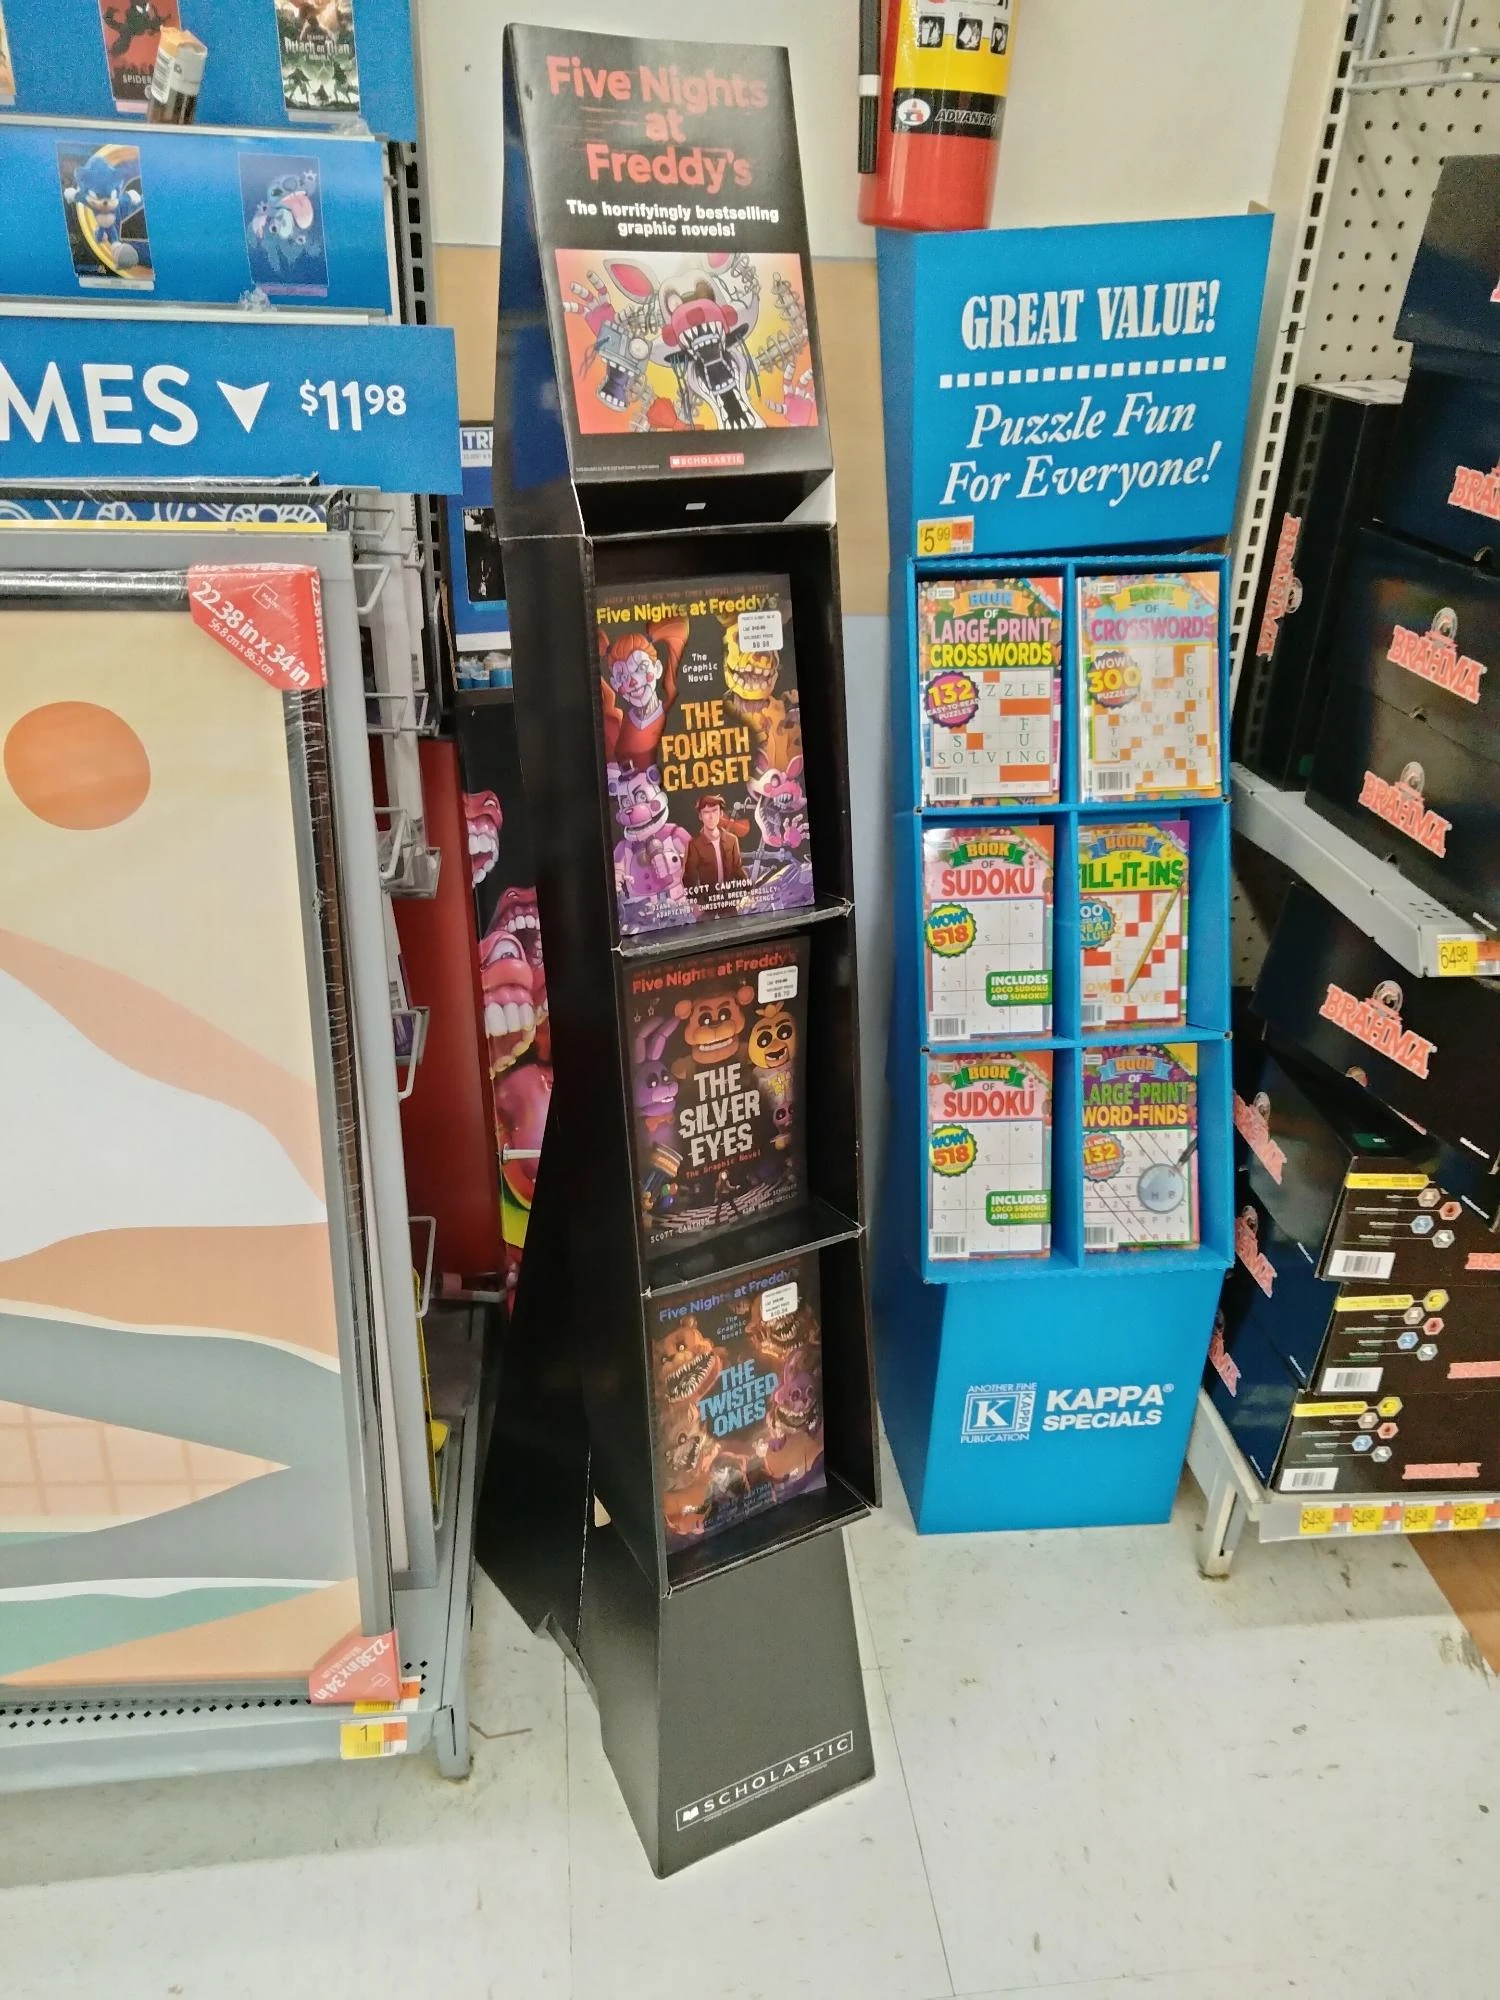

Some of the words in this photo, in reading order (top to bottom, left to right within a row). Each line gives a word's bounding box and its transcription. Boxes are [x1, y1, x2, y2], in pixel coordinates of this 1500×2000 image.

[284, 37, 315, 54] Attack
[325, 38, 350, 55] Titan
[546, 55, 632, 101] Five
[640, 64, 769, 112] Nights
[645, 105, 686, 143] at
[586, 142, 753, 194] Freddy's
[566, 199, 598, 217] The
[601, 202, 692, 221] horrifyingly
[695, 204, 780, 224] bestselling
[617, 221, 677, 238] graphic
[681, 223, 736, 238] novels!
[961, 288, 1085, 352] GREAT
[1096, 279, 1222, 342] VALUE!
[965, 395, 1104, 450] Puzzle
[1113, 391, 1195, 439] Fun
[463, 431, 494, 450] TR
[680, 454, 744, 467] SCHOLASTIC
[939, 461, 1011, 506] For
[1015, 440, 1223, 509] Everyone!
[596, 606, 631, 625] Five
[634, 602, 689, 623] Nights
[689, 600, 707, 616] at
[709, 593, 778, 612] Freddy's
[984, 609, 999, 620] OF
[1144, 604, 1160, 614] OF
[191, 580, 245, 629] 22.38
[238, 618, 259, 645] in
[255, 636, 272, 655] x
[267, 643, 297, 672] 34
[289, 660, 311, 687] in
[930, 617, 1052, 644] LARGE-PRINT
[1090, 614, 1217, 642] CROSSWORDS
[208, 617, 229, 638] 56.8
[226, 634, 240, 648] cm
[260, 663, 275, 677] cm
[691, 652, 708, 662] The
[930, 641, 1053, 668] CROSSWORDS
[682, 661, 719, 674] Graphic
[688, 672, 714, 683] Novel
[1387, 624, 1487, 704] BRAHMA
[1087, 665, 1142, 693] 300
[928, 679, 976, 708] 132
[680, 700, 725, 731] THE
[661, 726, 751, 763] FOURTH
[662, 756, 752, 792] CLOSET
[1358, 770, 1452, 858] BRAHMA
[966, 841, 1010, 857] BOOK
[1119, 851, 1132, 860] OF
[981, 860, 995, 869] OF
[1079, 860, 1184, 889] ILL-IT-INS
[683, 885, 710, 897] SCOTT
[941, 867, 1035, 897] SUDOKU
[932, 926, 969, 947] 518
[631, 977, 664, 995] Five
[717, 962, 733, 977] at
[991, 973, 1049, 986] INCLUDES
[991, 985, 1013, 994] LOCO
[1014, 983, 1048, 993] SUDOKU
[991, 993, 1009, 1001] AND
[1319, 983, 1437, 1080] BRAHMA
[969, 1065, 1011, 1080] BOOK
[1115, 1058, 1156, 1072] BOOK
[1128, 1073, 1142, 1083] OF
[693, 1062, 742, 1102] THE
[982, 1082, 995, 1091] OF
[679, 1089, 761, 1139] SILVER
[943, 1089, 1035, 1117] SUDOKU
[688, 1123, 753, 1167] EYES
[933, 1145, 970, 1167] 518
[1084, 1143, 1117, 1165] 132
[686, 1168, 699, 1179] The
[991, 1194, 1048, 1205] INCLUDES
[991, 1204, 1013, 1213] LOCO
[991, 1212, 1009, 1221] AND
[650, 1229, 674, 1245] SCOTT
[659, 1305, 688, 1323] Five
[733, 1285, 748, 1299] at
[719, 1358, 755, 1392] THE
[967, 1384, 1014, 1394] ANOTHER
[1015, 1382, 1038, 1392] FINE
[697, 1372, 779, 1422] TWISTED
[713, 1399, 766, 1438] ONES
[972, 1399, 1011, 1428] K
[1018, 1393, 1034, 1431] KAPPA
[1042, 1409, 1162, 1432] SPECIALS
[960, 1433, 1030, 1444] PUBLICATION
[703, 1738, 849, 1814] SCHOLASTIC
